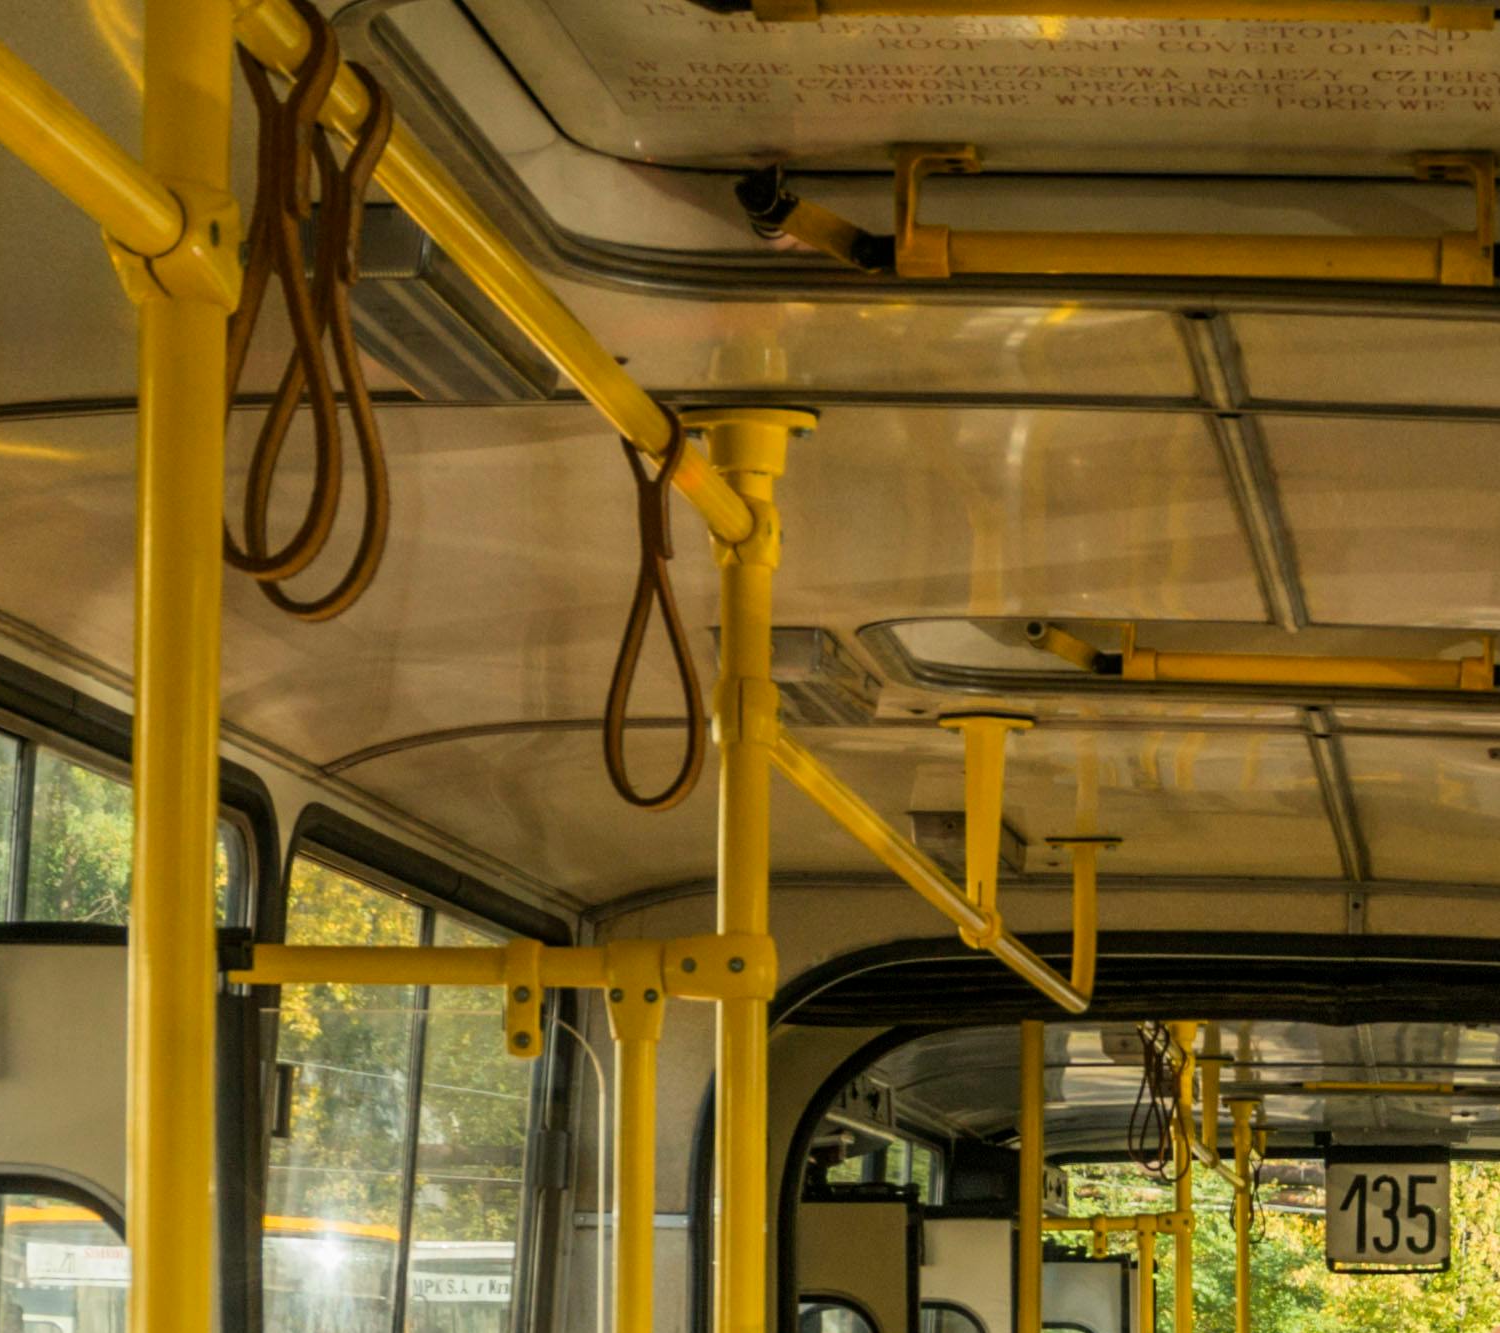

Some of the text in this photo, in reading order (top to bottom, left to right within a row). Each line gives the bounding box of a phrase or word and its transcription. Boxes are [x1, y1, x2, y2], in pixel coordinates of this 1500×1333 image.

[698, 20, 788, 33] THE
[817, 21, 922, 35] LEAD
[1089, 23, 1216, 38] UNTIL
[1244, 26, 1353, 40] STOP
[1387, 28, 1470, 41] AND
[878, 37, 988, 51] ROOF
[1018, 39, 1129, 52] VENT
[1157, 40, 1298, 54] COVER
[635, 61, 658, 72] W
[687, 62, 793, 75] RAZIE
[628, 76, 771, 89] KOLORU
[796, 77, 1042, 91] CZERWONEGO
[1323, 83, 1369, 96] DO
[1340, 1174, 1437, 1254] 135
